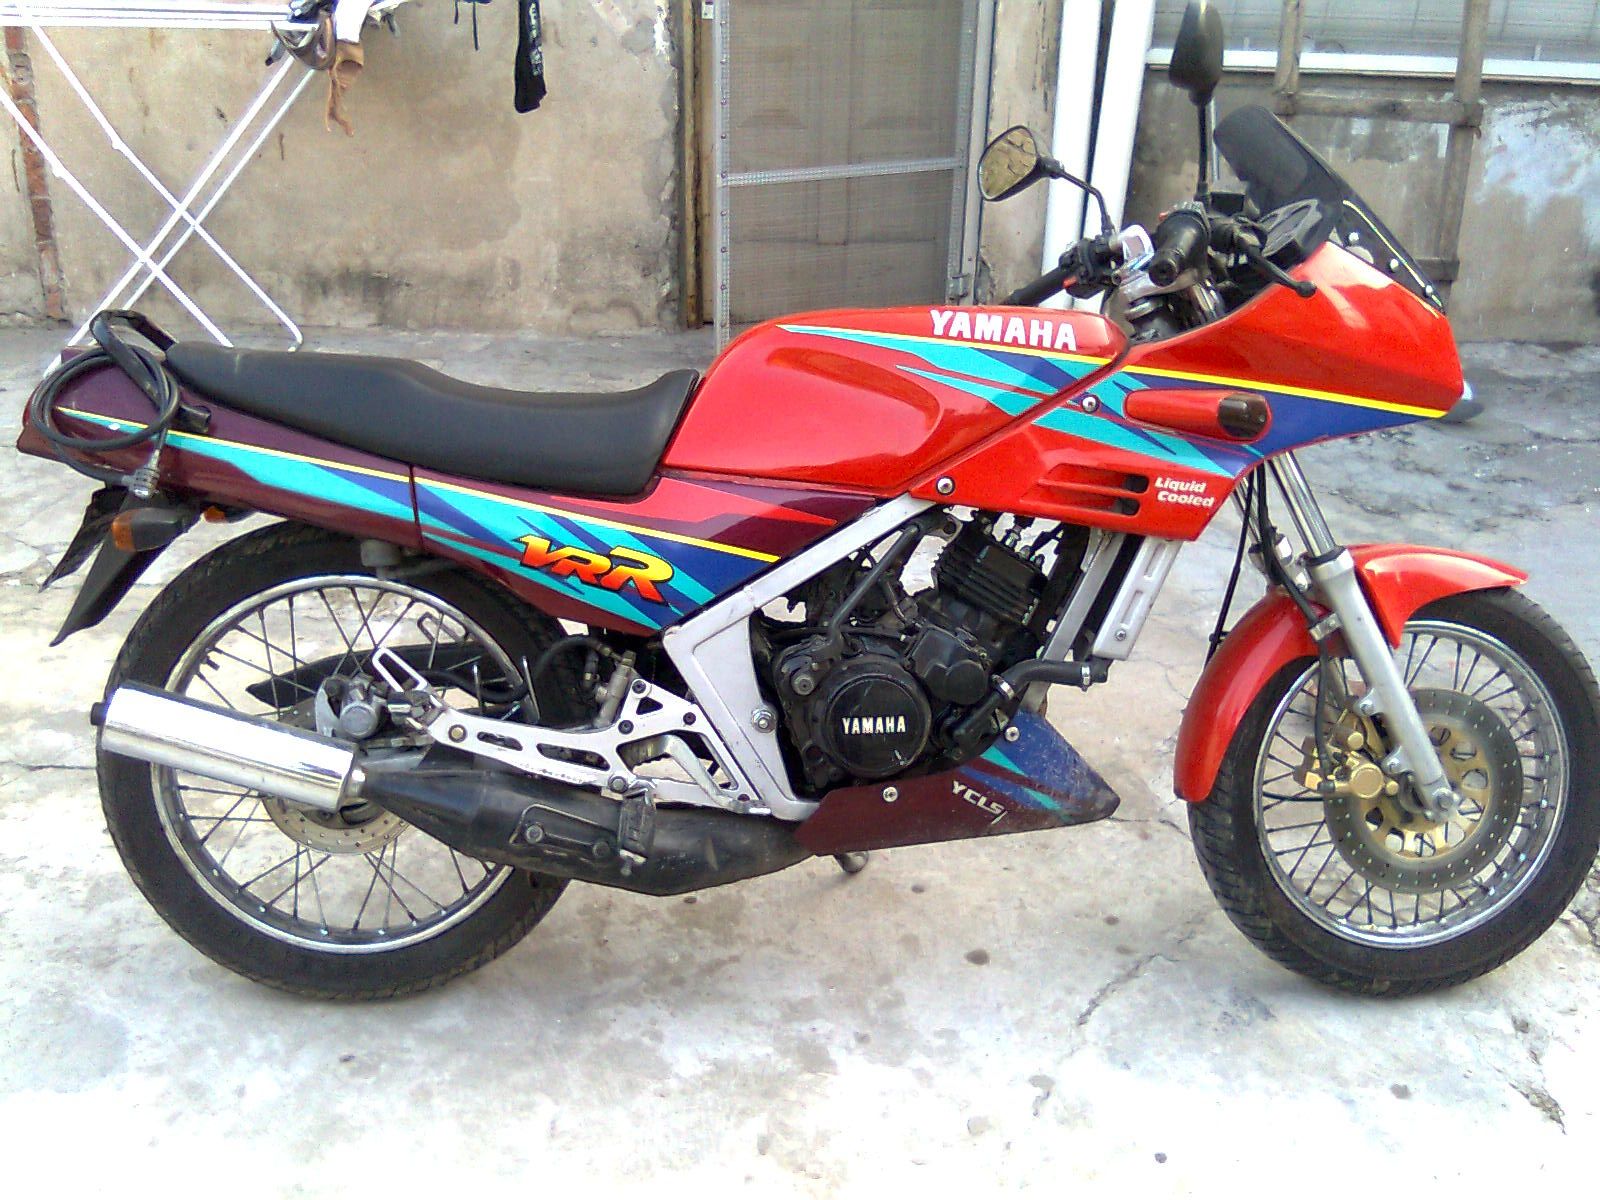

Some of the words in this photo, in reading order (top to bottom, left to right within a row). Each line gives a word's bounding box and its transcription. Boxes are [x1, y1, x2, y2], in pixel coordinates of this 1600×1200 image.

[930, 309, 1077, 352] YAMAHA
[1154, 476, 1206, 493] Liquid
[1157, 490, 1215, 507] Cooled
[841, 715, 907, 735] YAMAHA
